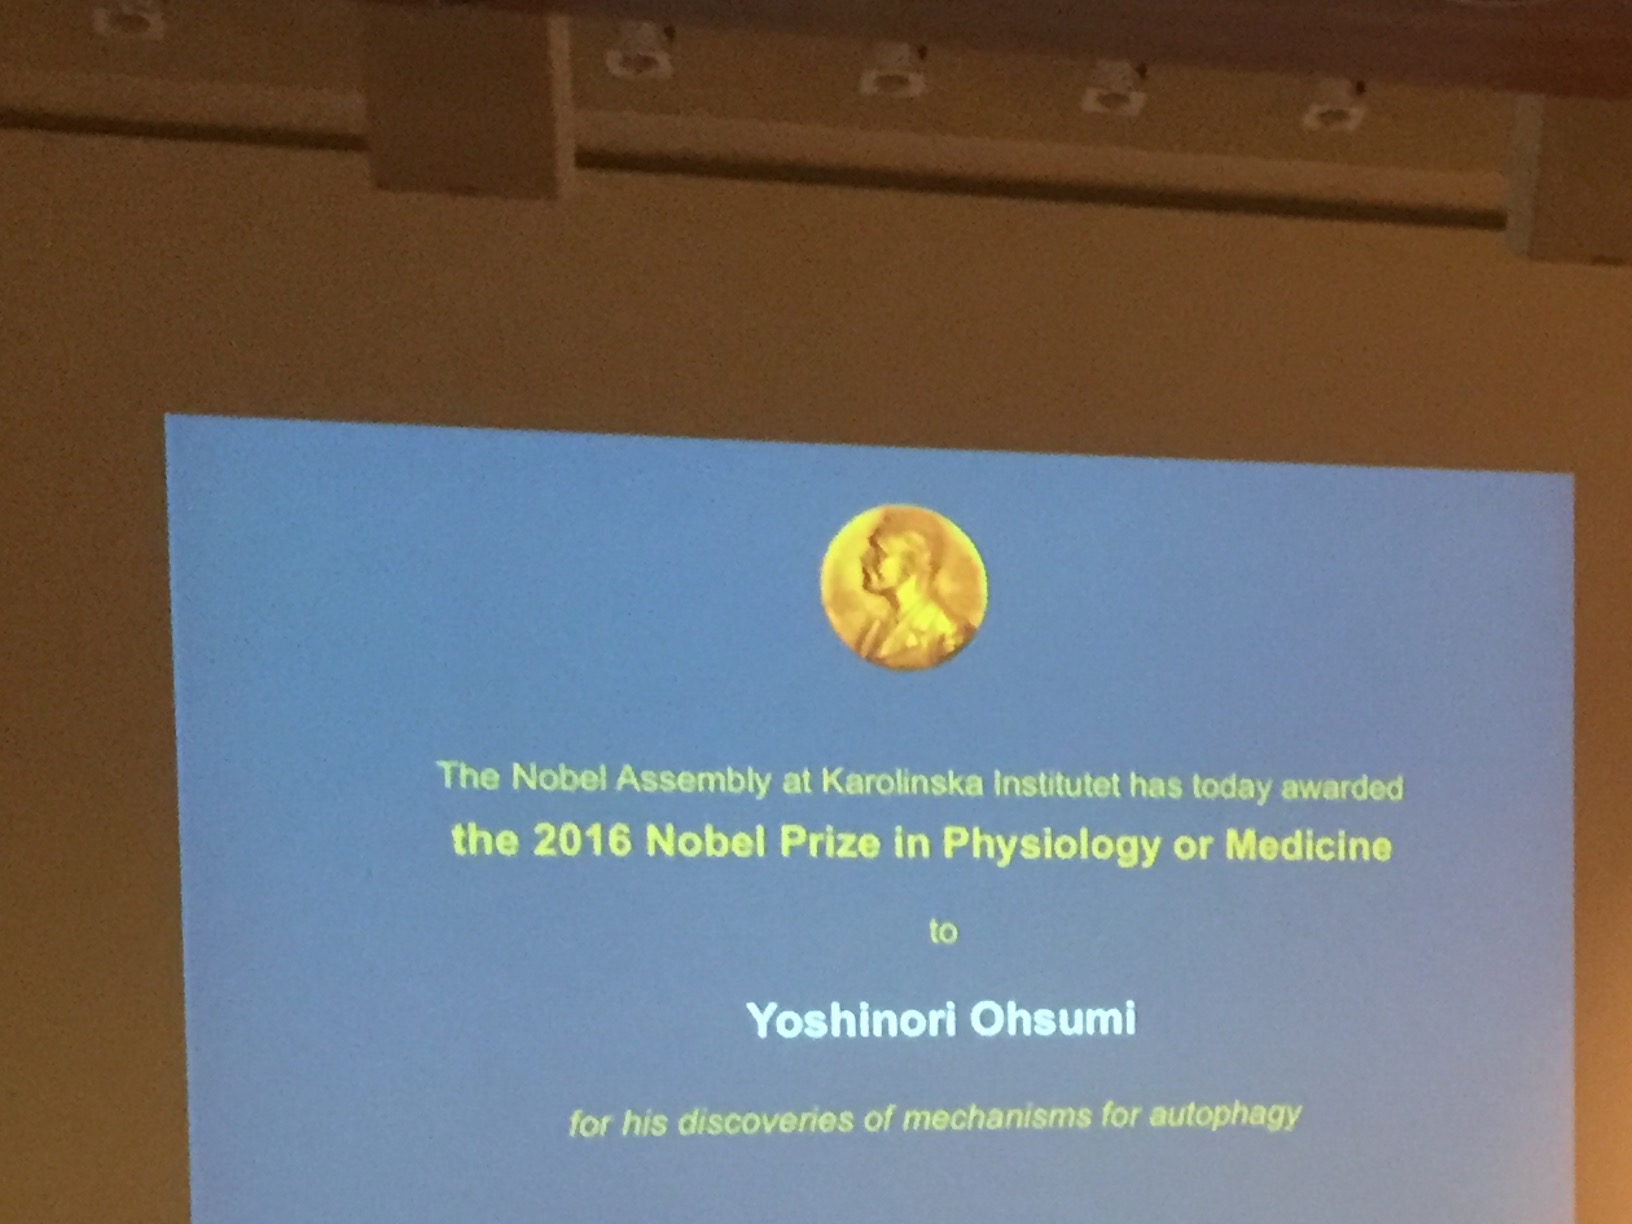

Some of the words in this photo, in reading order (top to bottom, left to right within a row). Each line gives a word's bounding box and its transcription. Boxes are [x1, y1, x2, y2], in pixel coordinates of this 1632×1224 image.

[437, 760, 500, 790] The
[512, 762, 607, 792] Nobel
[615, 764, 772, 800] Assembly
[783, 767, 812, 794] at
[822, 766, 983, 797] Karolinska
[994, 769, 1121, 798] Institutet
[1130, 771, 1183, 799] has
[1192, 773, 1272, 806] today
[1281, 774, 1403, 801] awarded
[451, 821, 519, 857] the
[533, 822, 632, 857] 2016
[645, 823, 764, 858] Nobel
[779, 824, 881, 859] Prize
[894, 825, 930, 859] in
[943, 825, 1162, 869] Physiology
[1173, 835, 1214, 861] or
[1226, 828, 1392, 862] Medicine
[929, 918, 958, 944] to
[746, 1001, 956, 1040] Yoshinori
[970, 999, 1135, 1037] Ohsumi
[569, 1109, 614, 1137] for
[622, 1109, 668, 1136] his
[678, 1106, 854, 1136] discoveries
[864, 1104, 896, 1132] of
[902, 1103, 1092, 1131] mechanisms
[1102, 1100, 1142, 1128] for
[1149, 1099, 1302, 1132] autophagy
